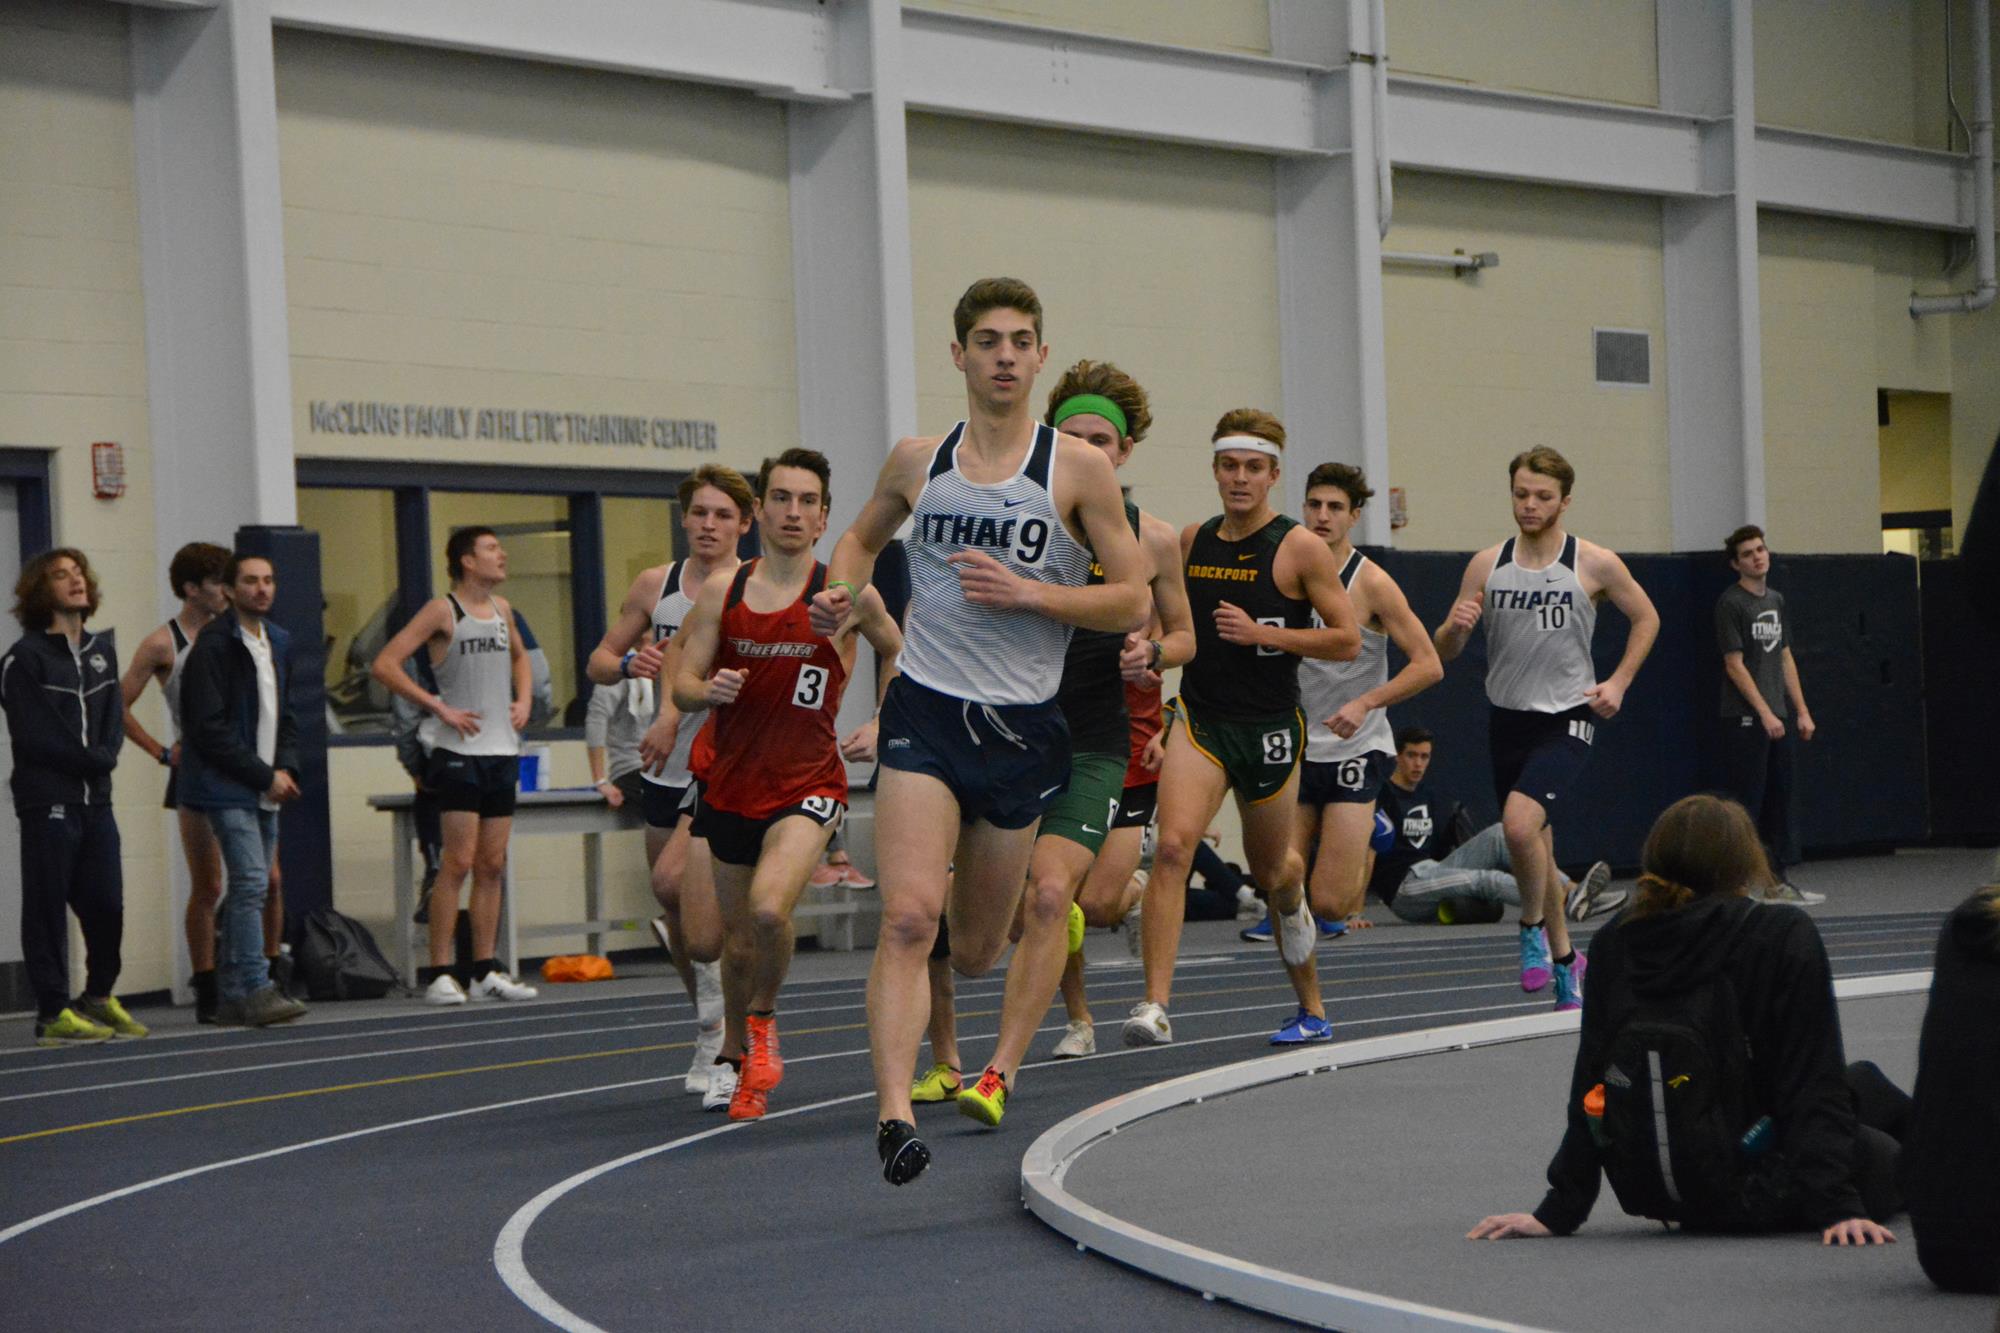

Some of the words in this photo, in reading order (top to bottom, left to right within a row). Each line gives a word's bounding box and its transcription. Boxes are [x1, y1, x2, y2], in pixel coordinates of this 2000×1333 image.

[310, 401, 399, 436] McCLUNG
[404, 404, 470, 439] FAMILY
[475, 408, 561, 443] ATHLETIC
[564, 412, 648, 446] TRAINING
[652, 417, 716, 450] CENTER
[923, 514, 1018, 549] ITHAC
[1016, 518, 1048, 564] 9
[1538, 606, 1564, 629] 10
[797, 669, 822, 706] 3
[1267, 732, 1286, 762] 8
[1341, 760, 1361, 786] 6
